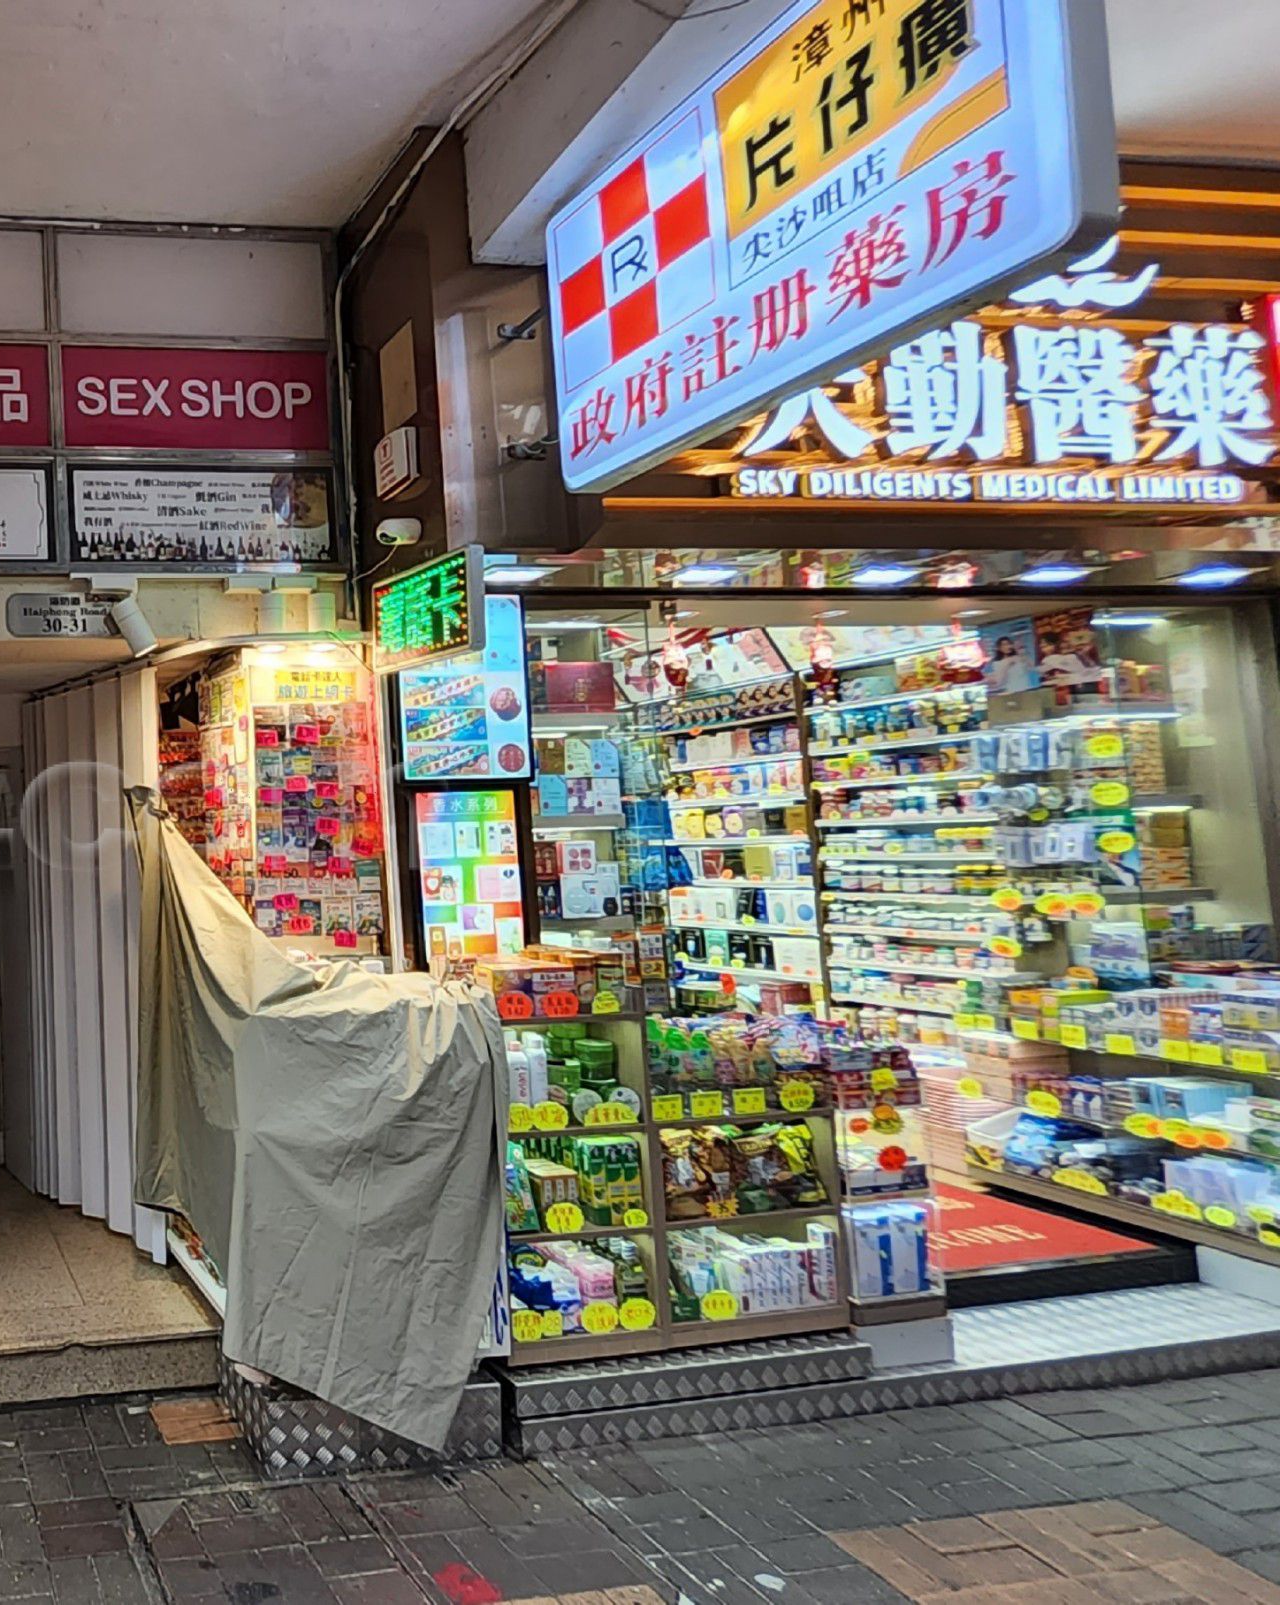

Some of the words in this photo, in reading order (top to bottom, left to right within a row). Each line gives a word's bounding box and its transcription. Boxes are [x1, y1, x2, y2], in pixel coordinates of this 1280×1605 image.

[741, 148, 887, 266] 尖沙咀店
[76, 376, 171, 418] SEX
[180, 379, 312, 420] SHOP
[738, 468, 797, 499] SKY
[810, 470, 972, 500] DILIGENTS
[982, 471, 1114, 500] MEDICAL
[1123, 472, 1241, 502] LIMITED
[23, 607, 77, 619] Haiphong
[41, 618, 89, 633] 30-31
[432, 798, 498, 811] 香水系列
